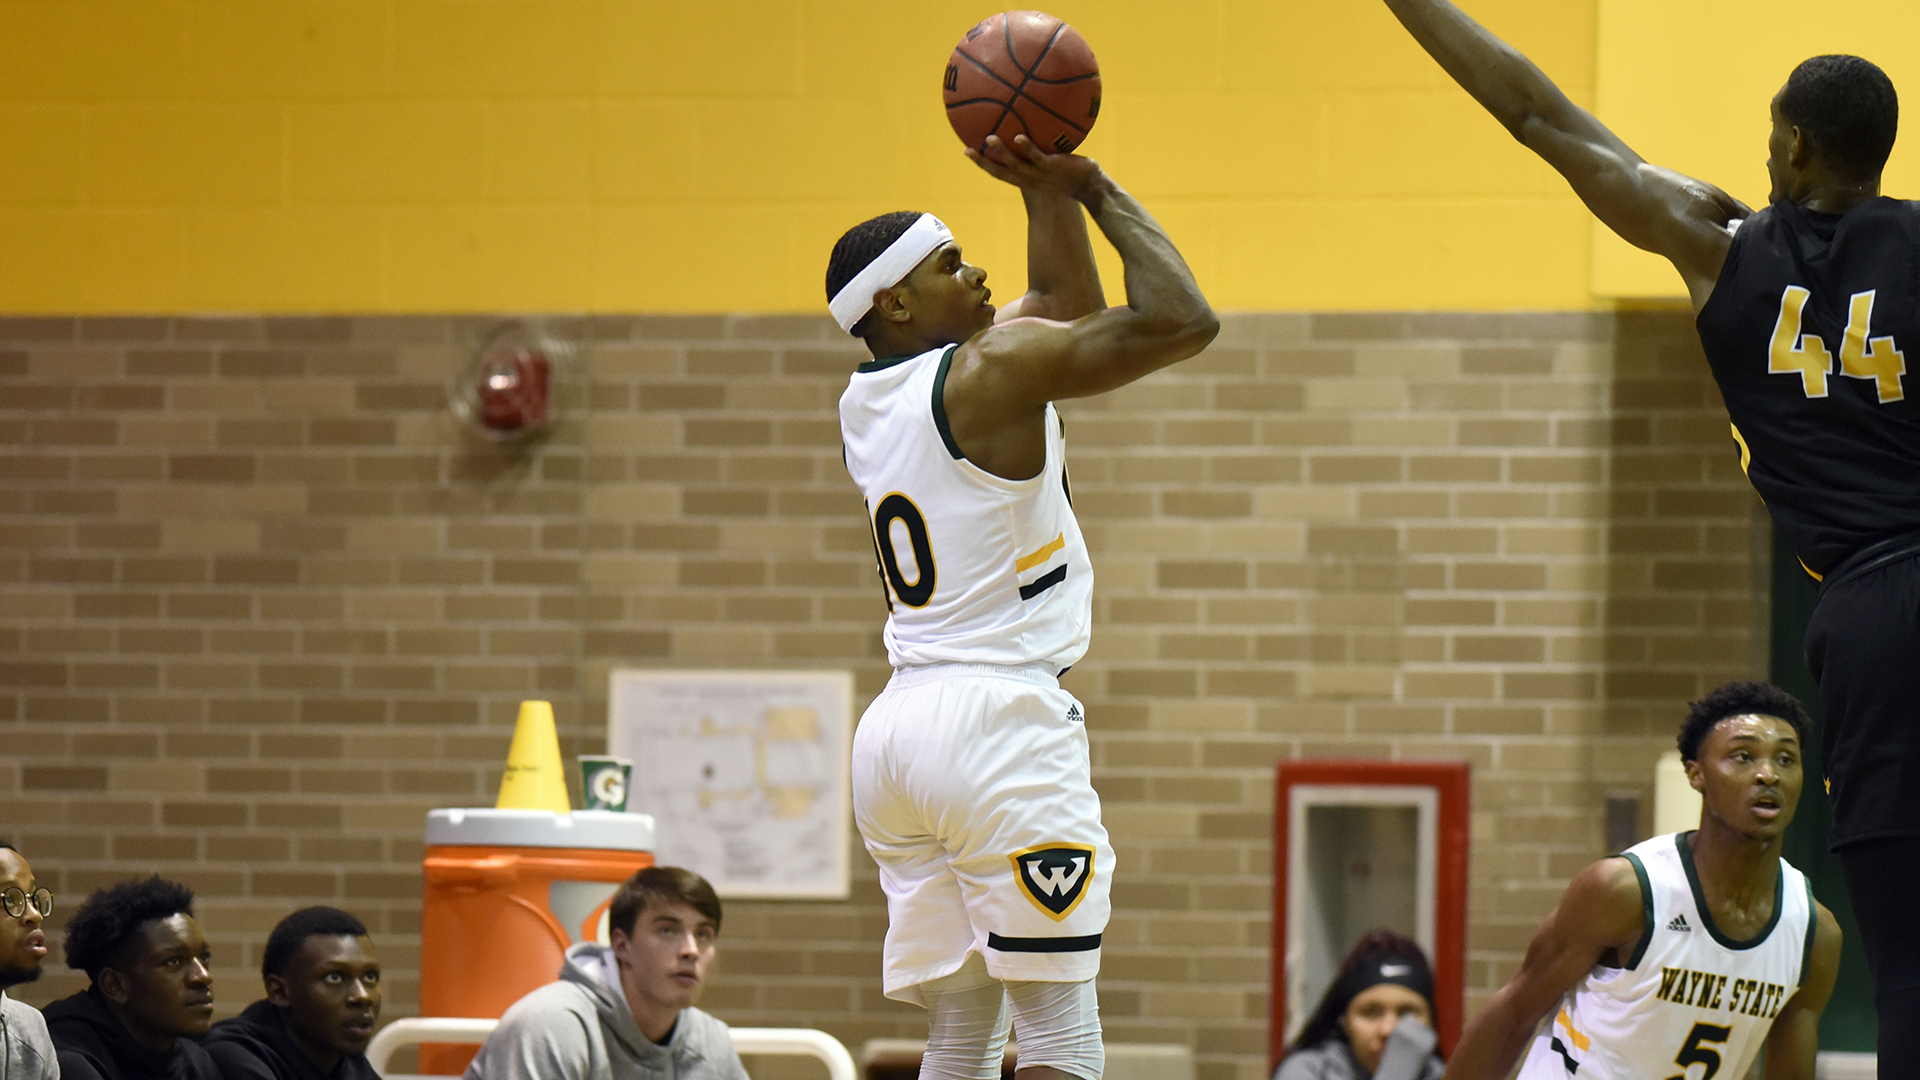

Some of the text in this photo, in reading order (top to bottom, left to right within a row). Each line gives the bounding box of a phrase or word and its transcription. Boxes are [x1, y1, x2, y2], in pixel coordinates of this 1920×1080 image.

[1768, 284, 1906, 404] 44
[864, 488, 938, 613] 0
[593, 767, 625, 806] G
[1026, 856, 1086, 897] W
[1656, 966, 1784, 1019] WAYNE STATE
[1664, 1021, 1734, 1080] 5
